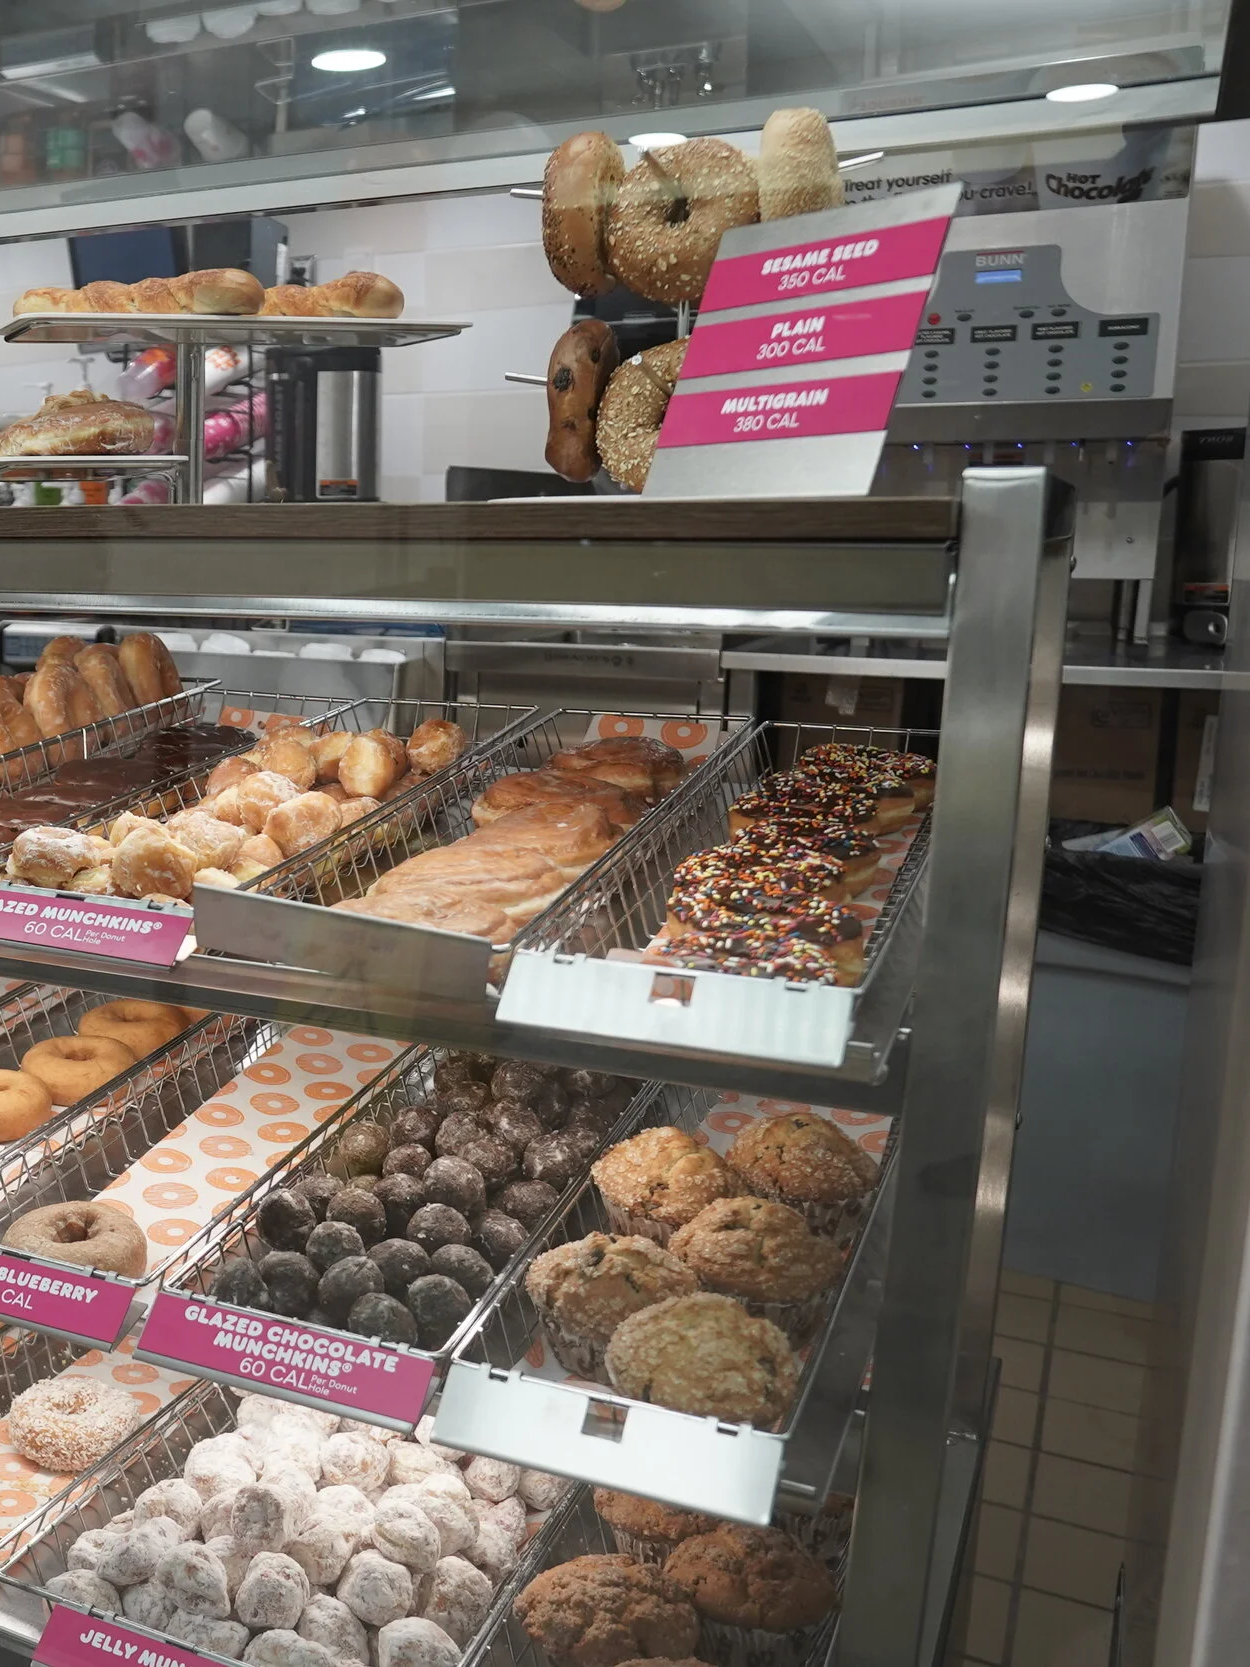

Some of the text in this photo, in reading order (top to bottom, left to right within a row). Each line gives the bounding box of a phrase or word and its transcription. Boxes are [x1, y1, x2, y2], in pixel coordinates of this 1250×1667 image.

[843, 168, 953, 193] Treat yourself
[1066, 172, 1101, 184] HOT
[760, 238, 880, 276] SESAME SEED
[975, 253, 1024, 268] BUNN
[777, 264, 846, 291] 350 CAL
[770, 315, 826, 339] PLAIN
[756, 336, 826, 361] 300 CAL
[721, 387, 830, 415] MULTIGRAIN
[733, 411, 800, 433] 380 CAL
[23, 921, 84, 942] 60 CAL
[82, 936, 102, 945] Hole
[85, 929, 126, 943] Per Donut
[0, 1289, 33, 1310] CAL
[184, 1305, 399, 1373] GLAZED CHOCOLATE
[239, 1357, 309, 1390] 60 CAL
[310, 1374, 358, 1395] Per Donut
[307, 1384, 330, 1397] Hole
[79, 1628, 138, 1660] JELLY
